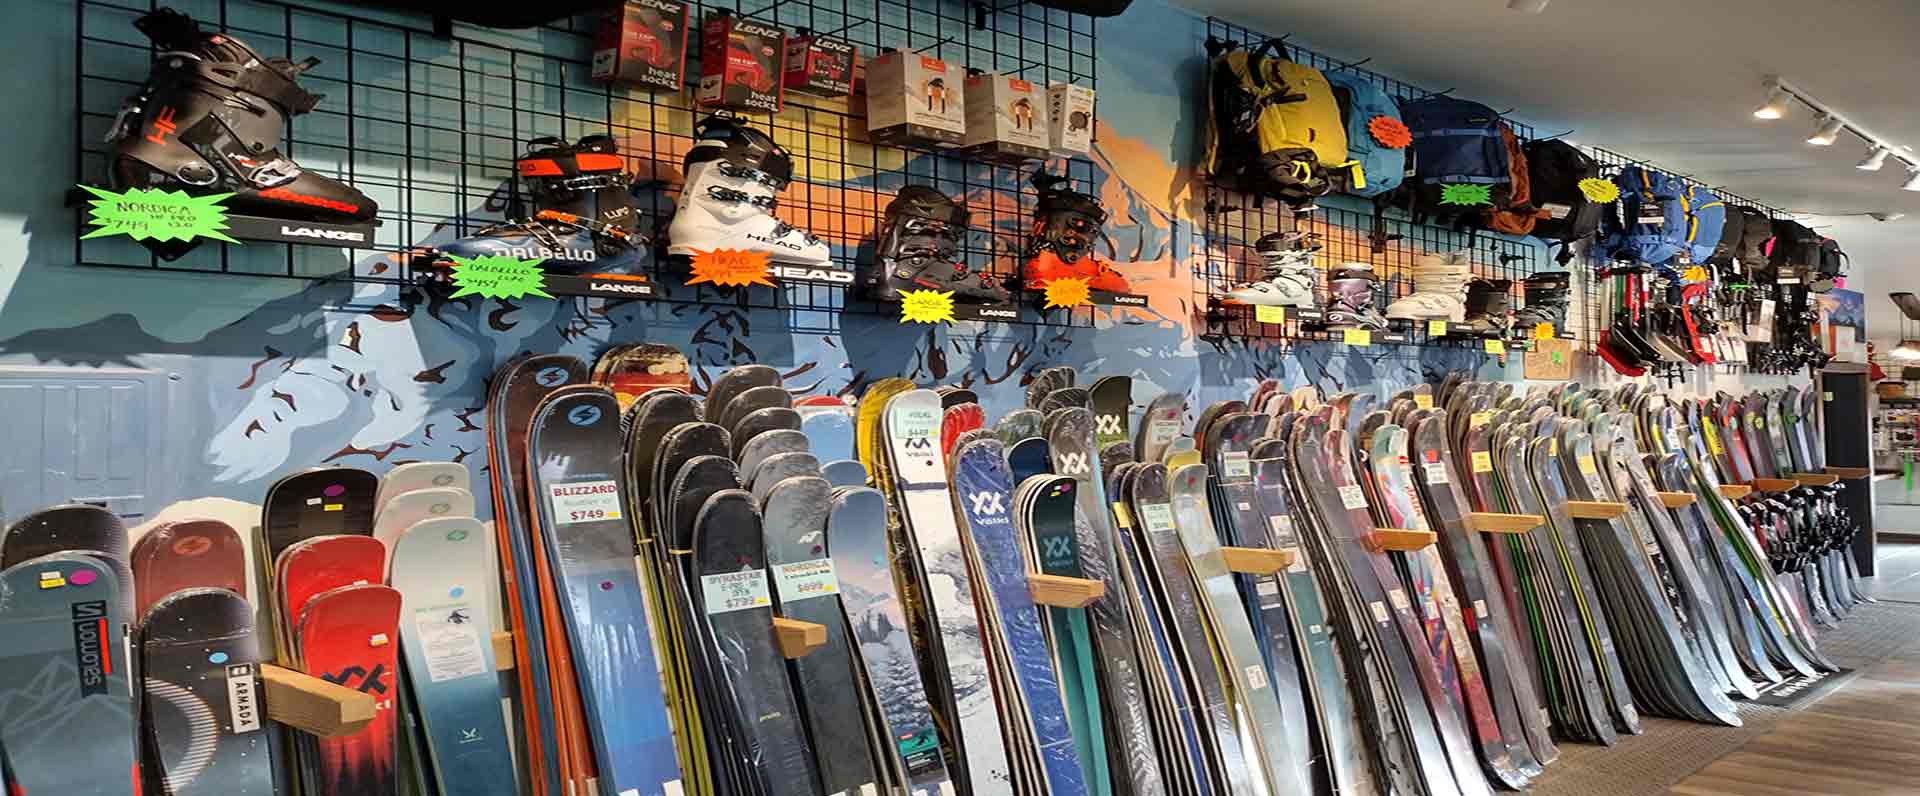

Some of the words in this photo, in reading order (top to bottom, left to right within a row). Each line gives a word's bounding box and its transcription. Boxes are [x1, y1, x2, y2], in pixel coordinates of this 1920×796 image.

[734, 22, 781, 39] LENZ
[815, 38, 851, 55] LENZ
[648, 67, 676, 80] heat
[751, 91, 777, 103] heat
[116, 201, 192, 215] NORDICA
[281, 226, 365, 242] LANGE
[746, 233, 802, 251] HEAD
[770, 266, 855, 283] HEAD
[591, 282, 651, 295] LANGE
[1115, 296, 1145, 304] LANGE
[979, 308, 1017, 318] LANGE
[553, 484, 616, 496] BLIZZARD
[570, 509, 604, 520] $749
[234, 682, 253, 726] ARMADA
